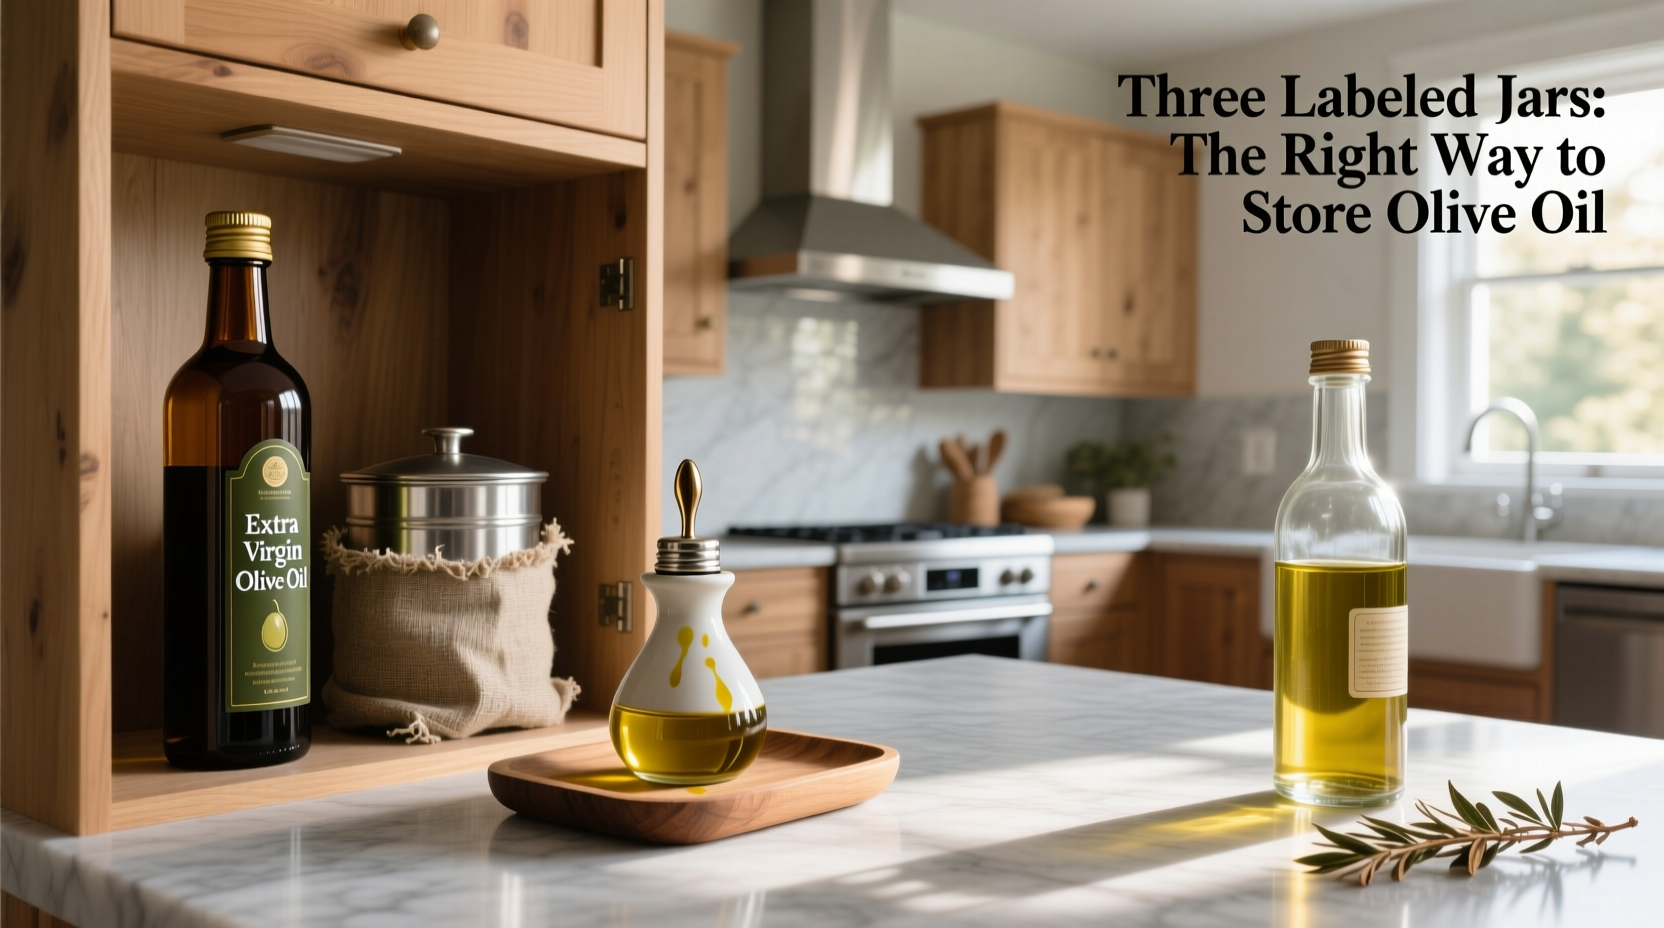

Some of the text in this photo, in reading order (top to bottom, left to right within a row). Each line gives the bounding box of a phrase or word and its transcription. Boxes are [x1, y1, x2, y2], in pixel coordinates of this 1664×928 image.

[244, 513, 299, 535] Extra
[242, 538, 303, 569] Virgin
[235, 566, 308, 592] Olive Oil
